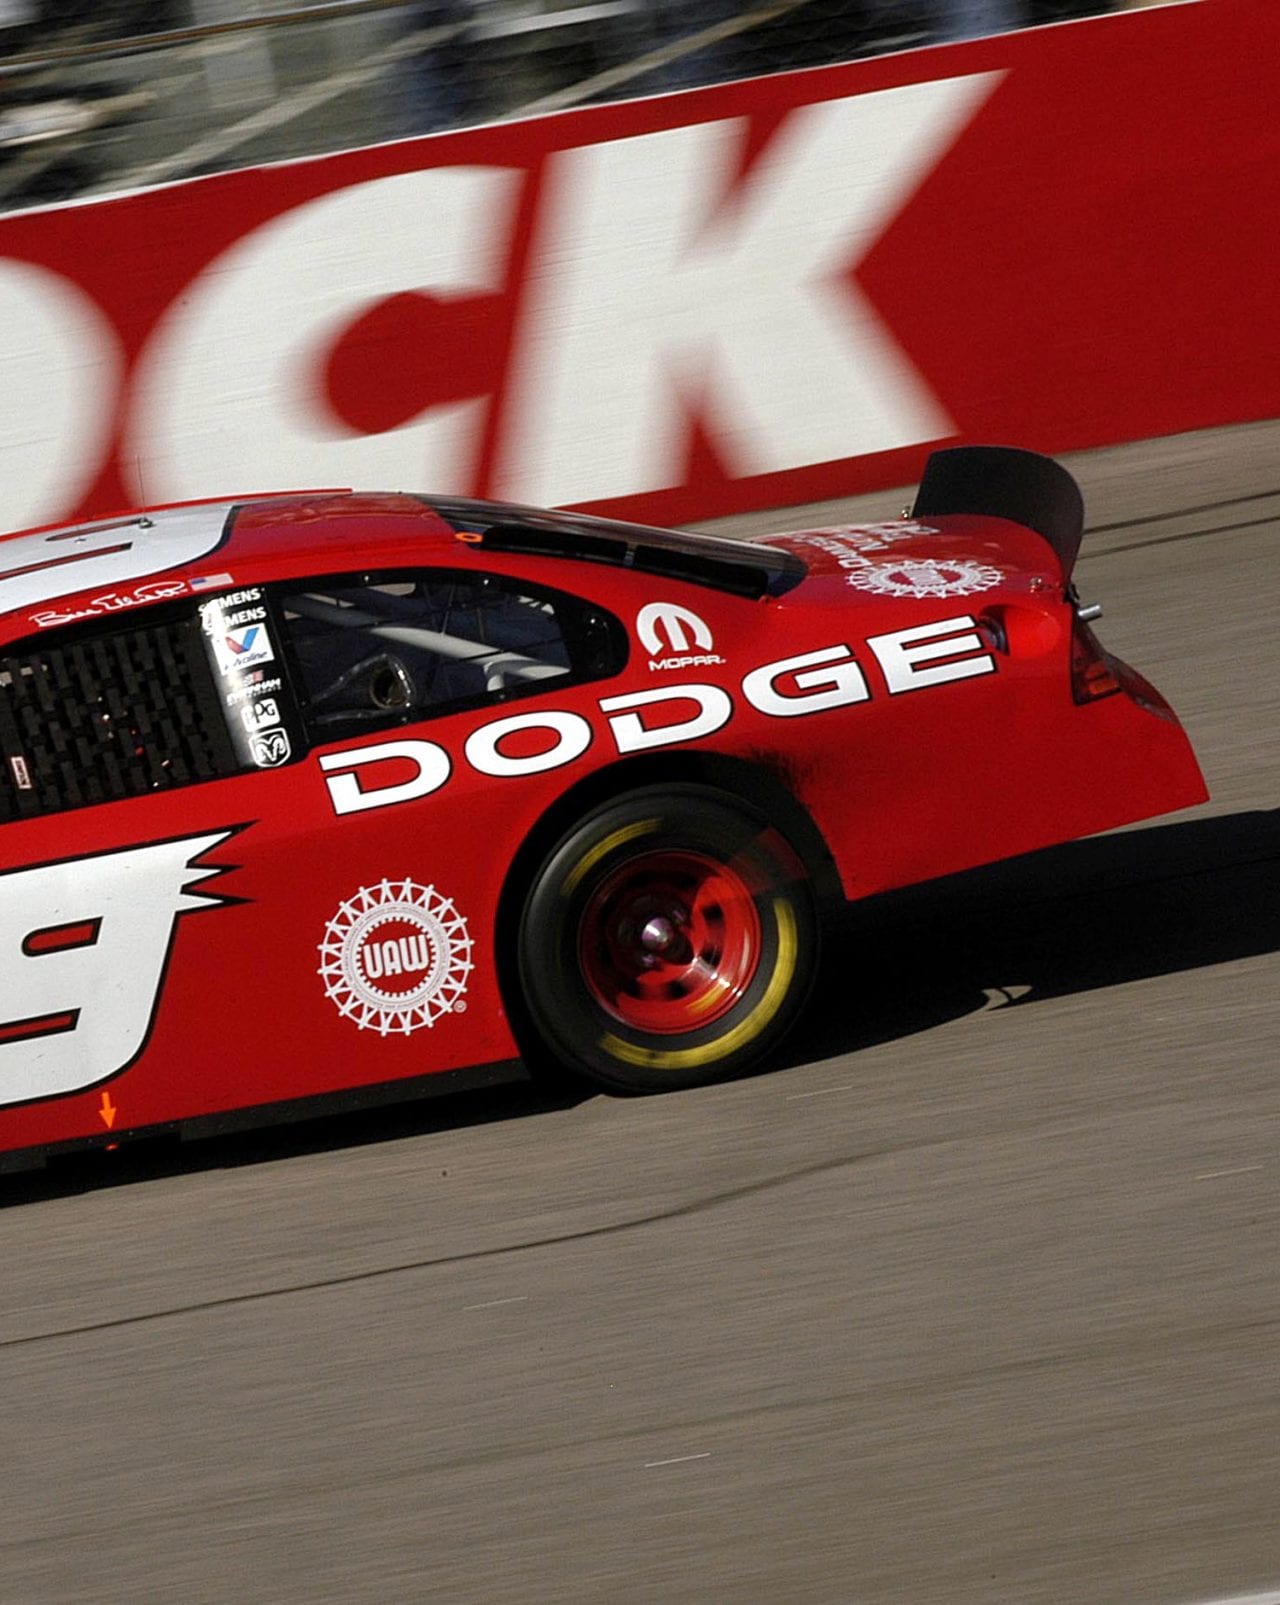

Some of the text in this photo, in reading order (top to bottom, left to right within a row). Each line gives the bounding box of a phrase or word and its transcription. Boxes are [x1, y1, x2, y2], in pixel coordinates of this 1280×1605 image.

[198, 587, 261, 613] SMENS
[649, 655, 720, 672] MOPAR
[320, 615, 995, 816] DODGE
[363, 934, 430, 979] UAW
